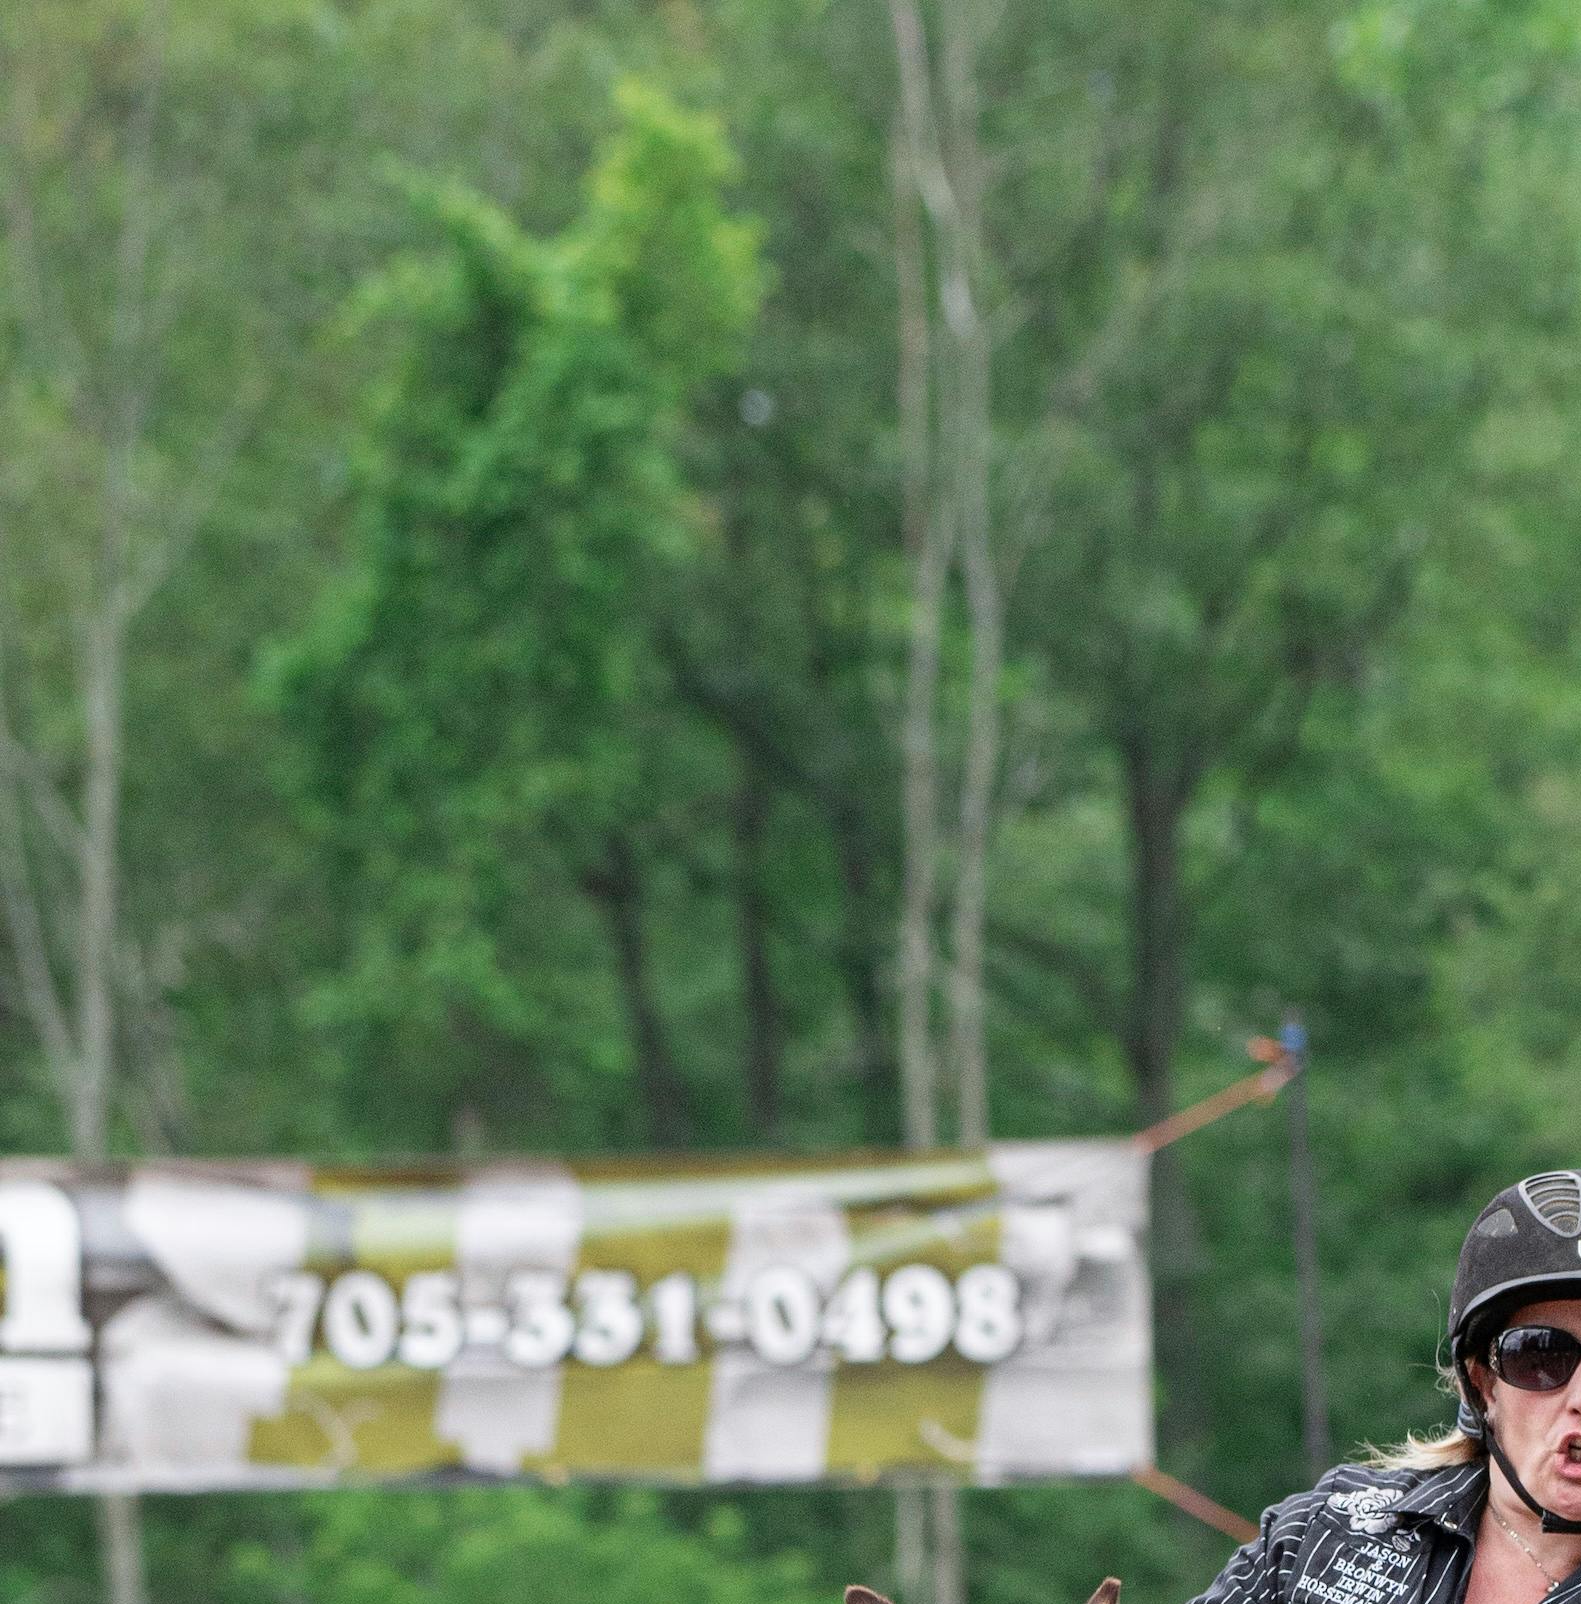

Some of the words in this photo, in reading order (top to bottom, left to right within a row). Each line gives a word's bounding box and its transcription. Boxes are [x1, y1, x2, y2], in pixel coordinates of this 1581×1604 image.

[1360, 1541, 1412, 1569] JASON
[1370, 1560, 1384, 1571] &
[1333, 1557, 1409, 1597] BRONWYN
[1336, 1576, 1386, 1603] IRWIN
